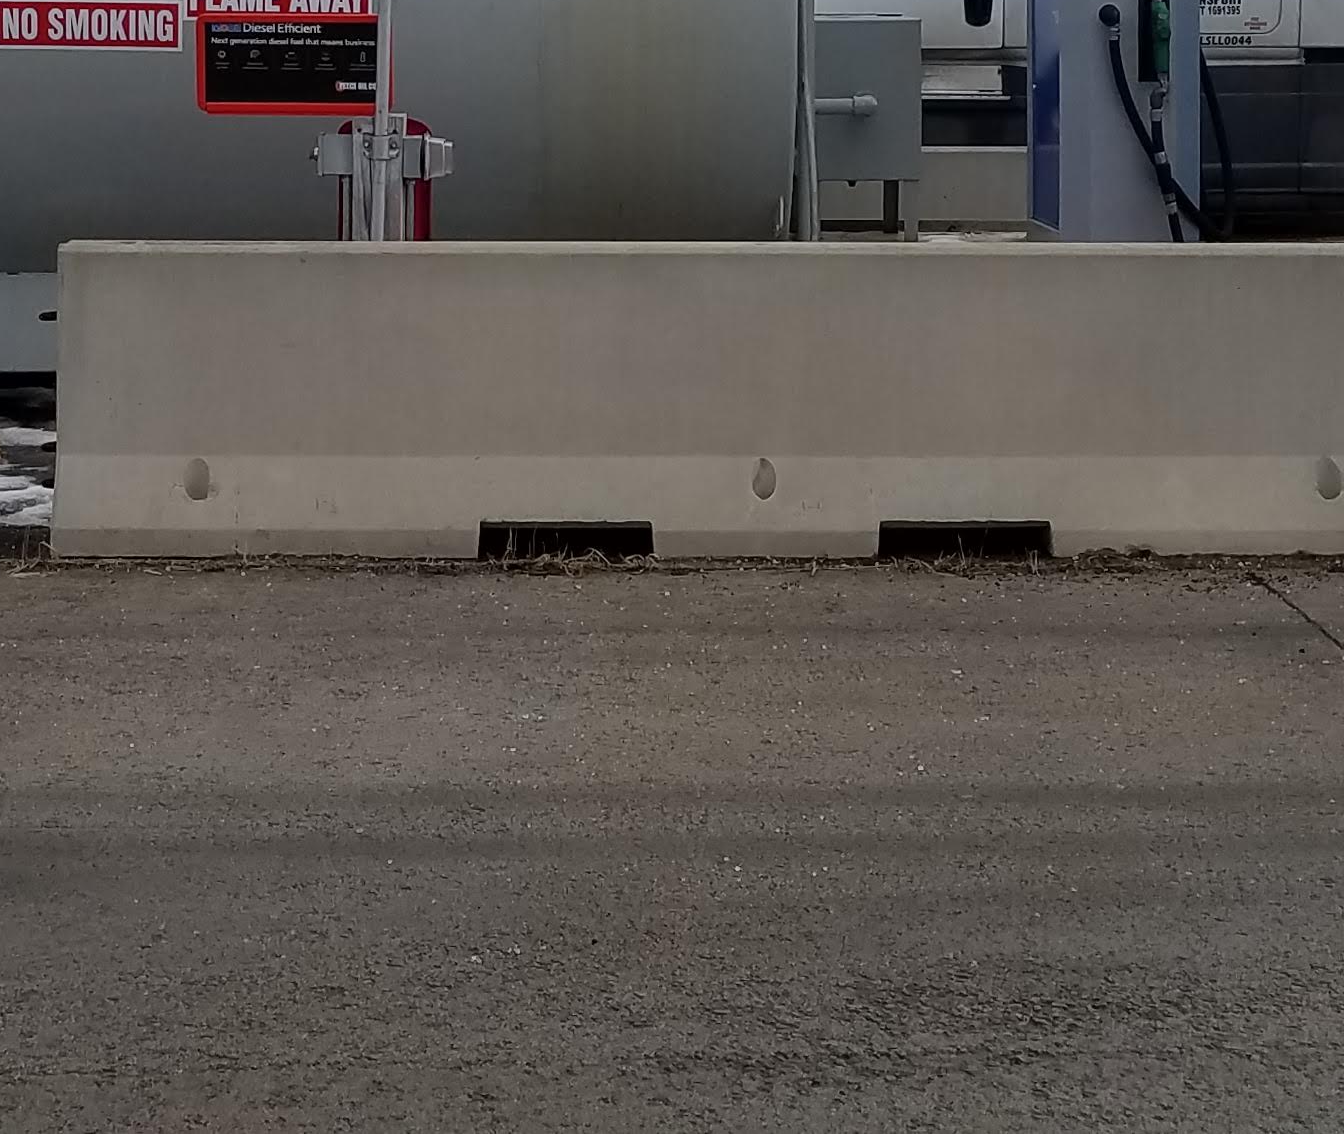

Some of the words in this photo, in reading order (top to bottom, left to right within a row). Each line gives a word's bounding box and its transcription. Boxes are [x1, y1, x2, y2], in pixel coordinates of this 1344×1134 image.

[2, 7, 38, 40] NO
[47, 8, 174, 42] SMOKING
[243, 22, 276, 33] Diesel
[277, 23, 322, 34] Efficient
[229, 37, 267, 46] generation
[268, 37, 289, 45] diesel
[305, 38, 320, 46] that
[344, 38, 376, 46] business
